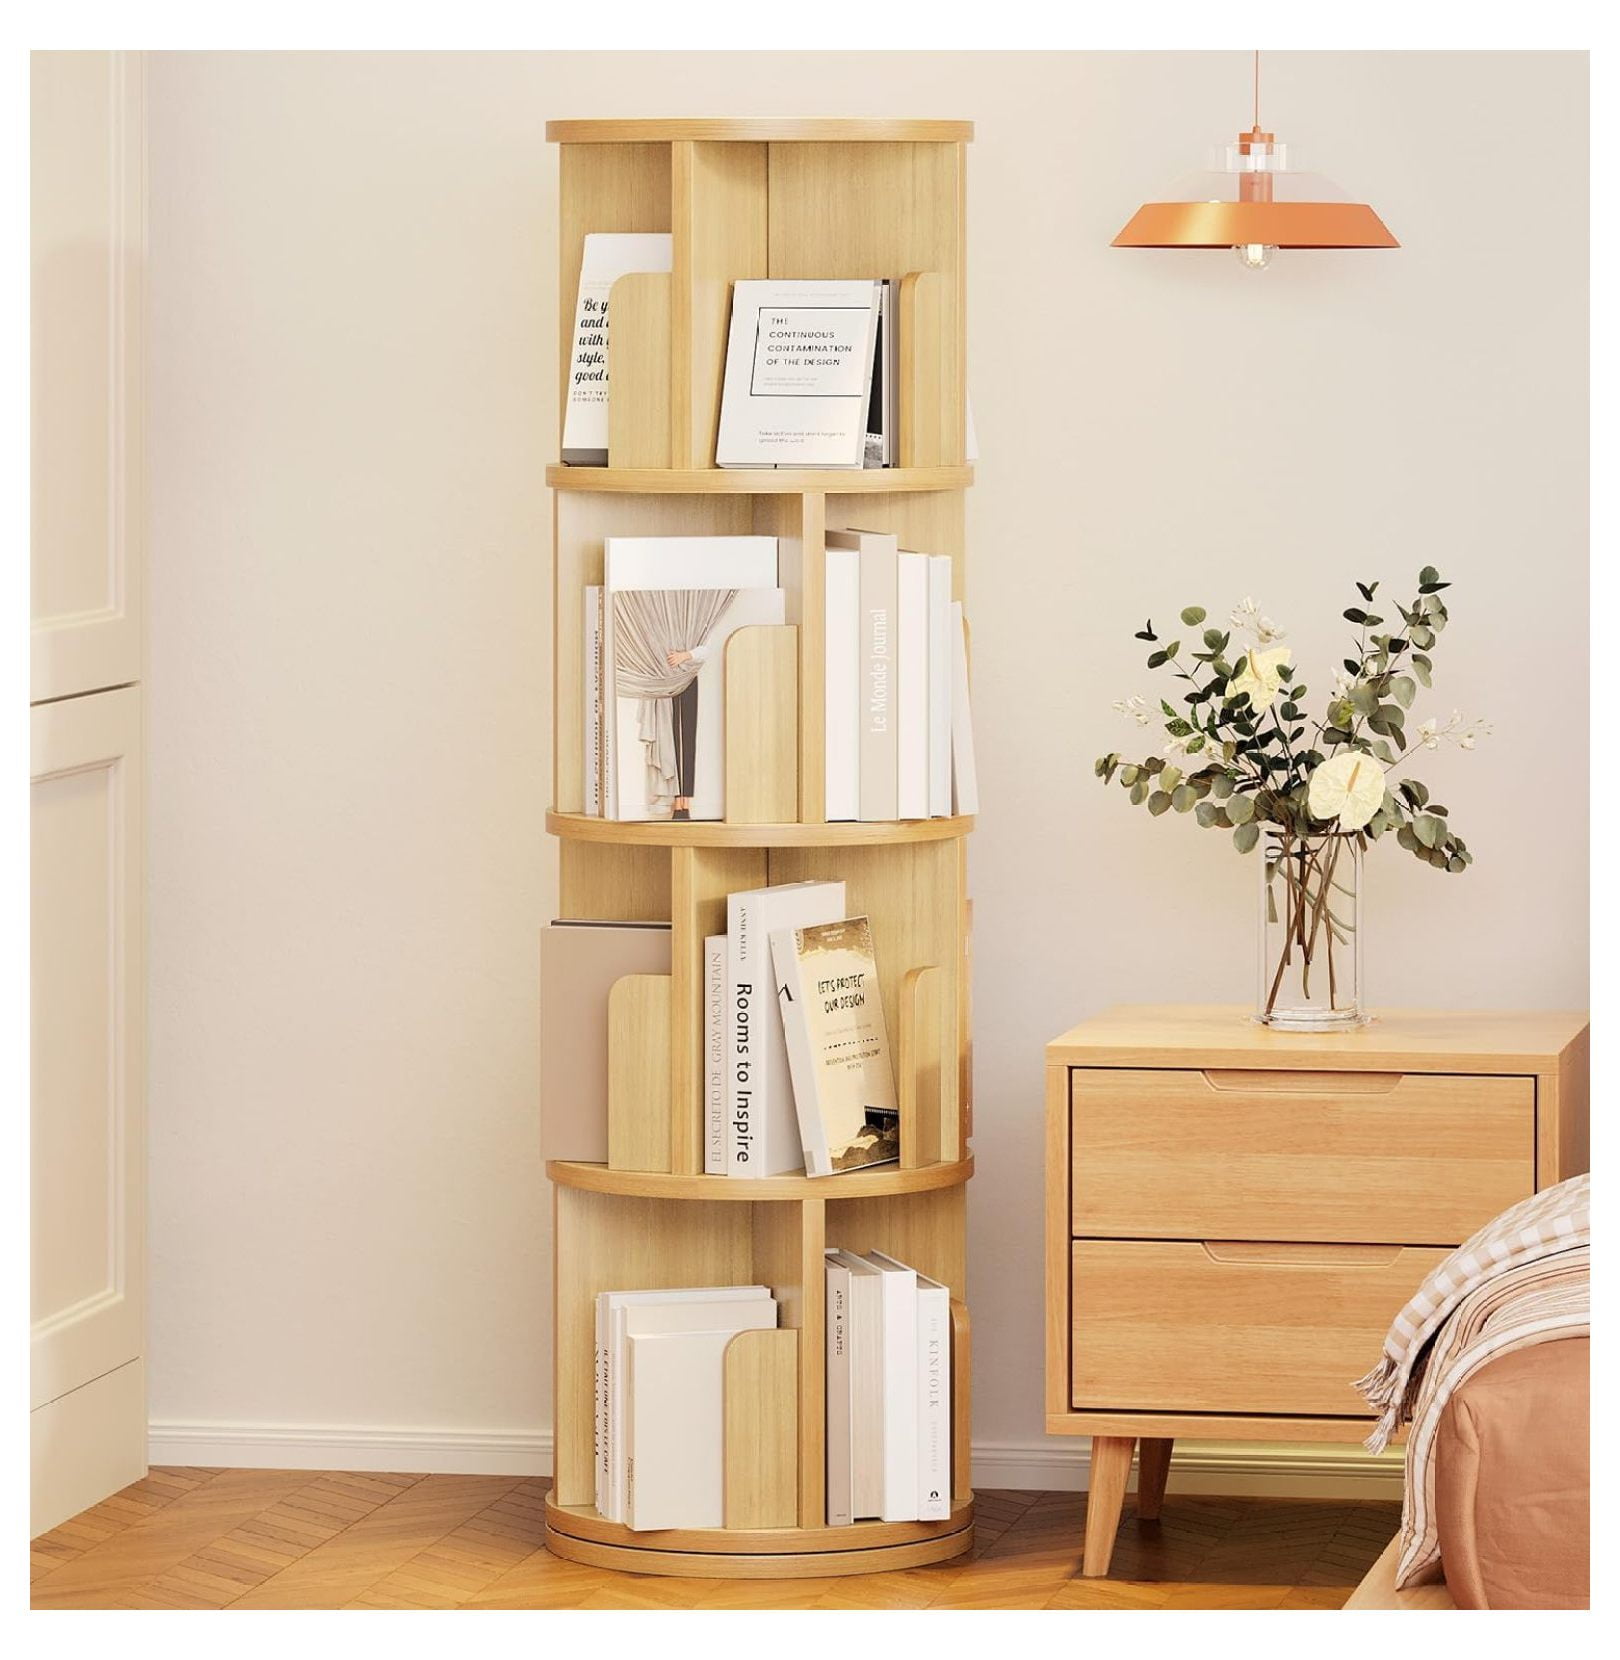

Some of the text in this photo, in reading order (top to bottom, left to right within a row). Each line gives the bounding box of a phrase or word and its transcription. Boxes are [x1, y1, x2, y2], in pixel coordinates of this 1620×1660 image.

[583, 297, 599, 312] Be
[580, 316, 605, 328] and
[771, 317, 788, 325] THE
[578, 333, 603, 346] with
[768, 331, 835, 339] CONTINUOUS
[767, 345, 853, 353] CONTAMINATION
[576, 351, 605, 368] style,
[766, 358, 841, 366] OF THE DESIGN
[575, 369, 604, 385] good
[869, 608, 891, 733] Le Monde Journal
[824, 991, 865, 1014] OUR DESIGN
[711, 951, 722, 1163] EL SECRETO DE GRAY MOUNTAIN
[732, 984, 753, 1163] Rooms to Inspire
[929, 1340, 940, 1408] KINFOLK
